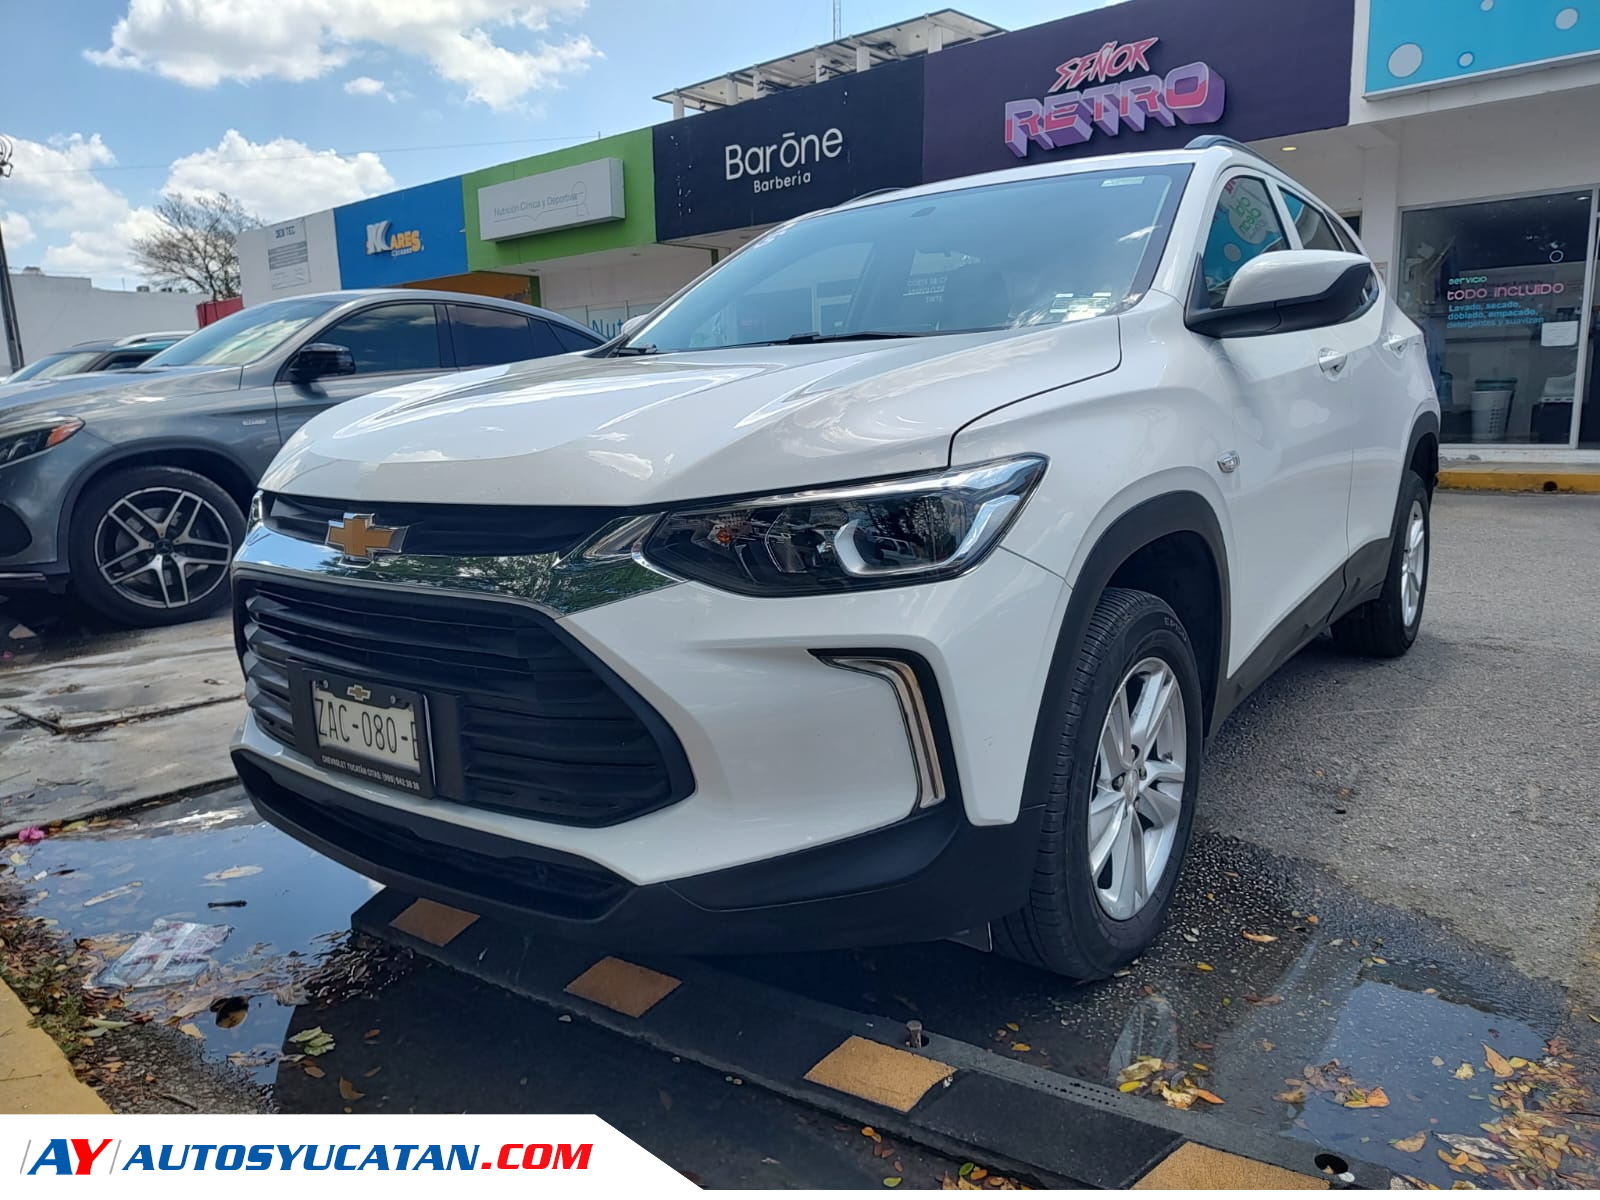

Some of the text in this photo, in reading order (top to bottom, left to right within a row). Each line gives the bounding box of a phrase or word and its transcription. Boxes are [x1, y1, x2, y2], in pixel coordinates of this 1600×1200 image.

[1048, 37, 1159, 92] SEÑOR
[1005, 62, 1224, 157] RETRO
[1448, 276, 1488, 285] servicio
[321, 754, 347, 769] CHEVROLET
